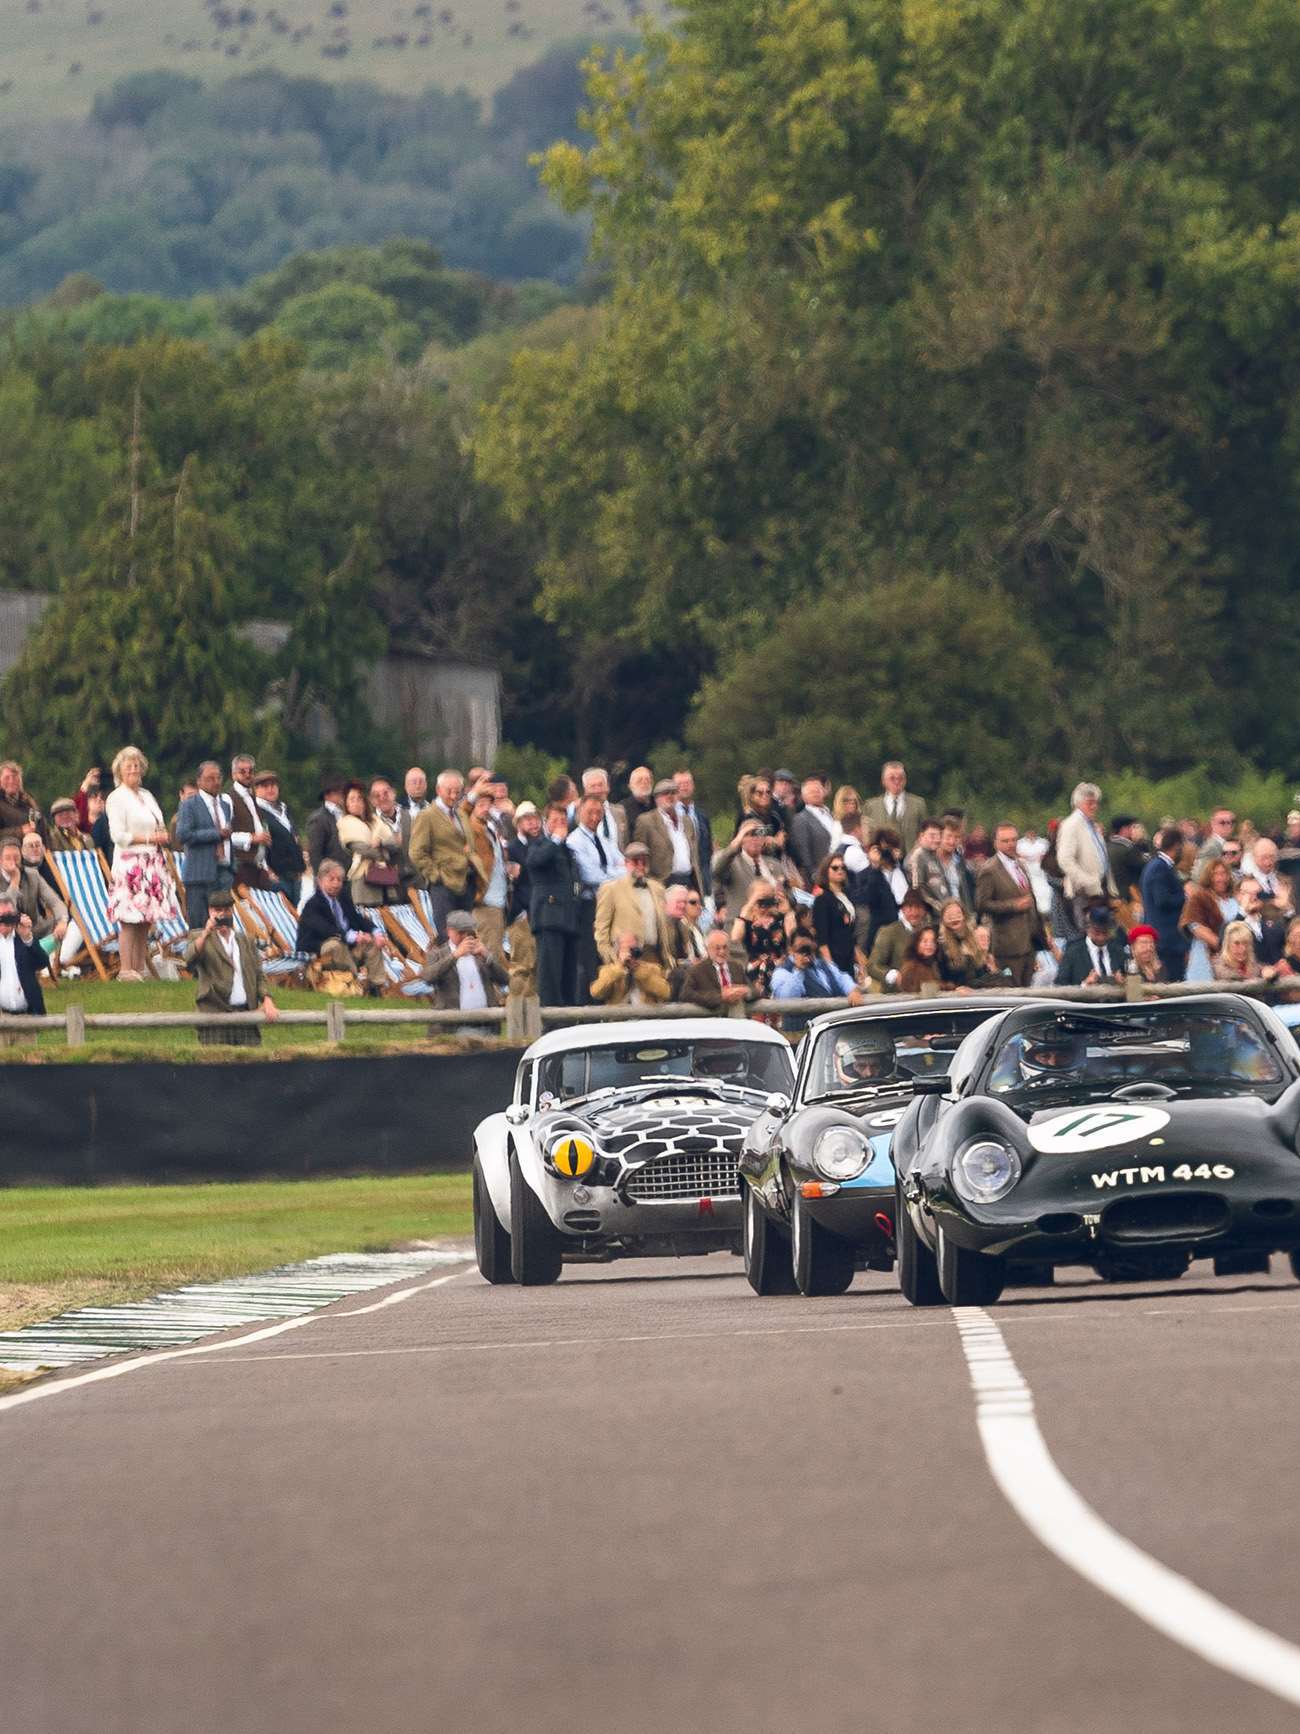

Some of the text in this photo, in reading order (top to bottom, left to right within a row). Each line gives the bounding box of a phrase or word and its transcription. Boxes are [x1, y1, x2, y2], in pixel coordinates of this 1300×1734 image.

[1054, 1113, 1143, 1136] 17
[1091, 1163, 1235, 1189] WTM 446
[1083, 1214, 1101, 1226] TOW
